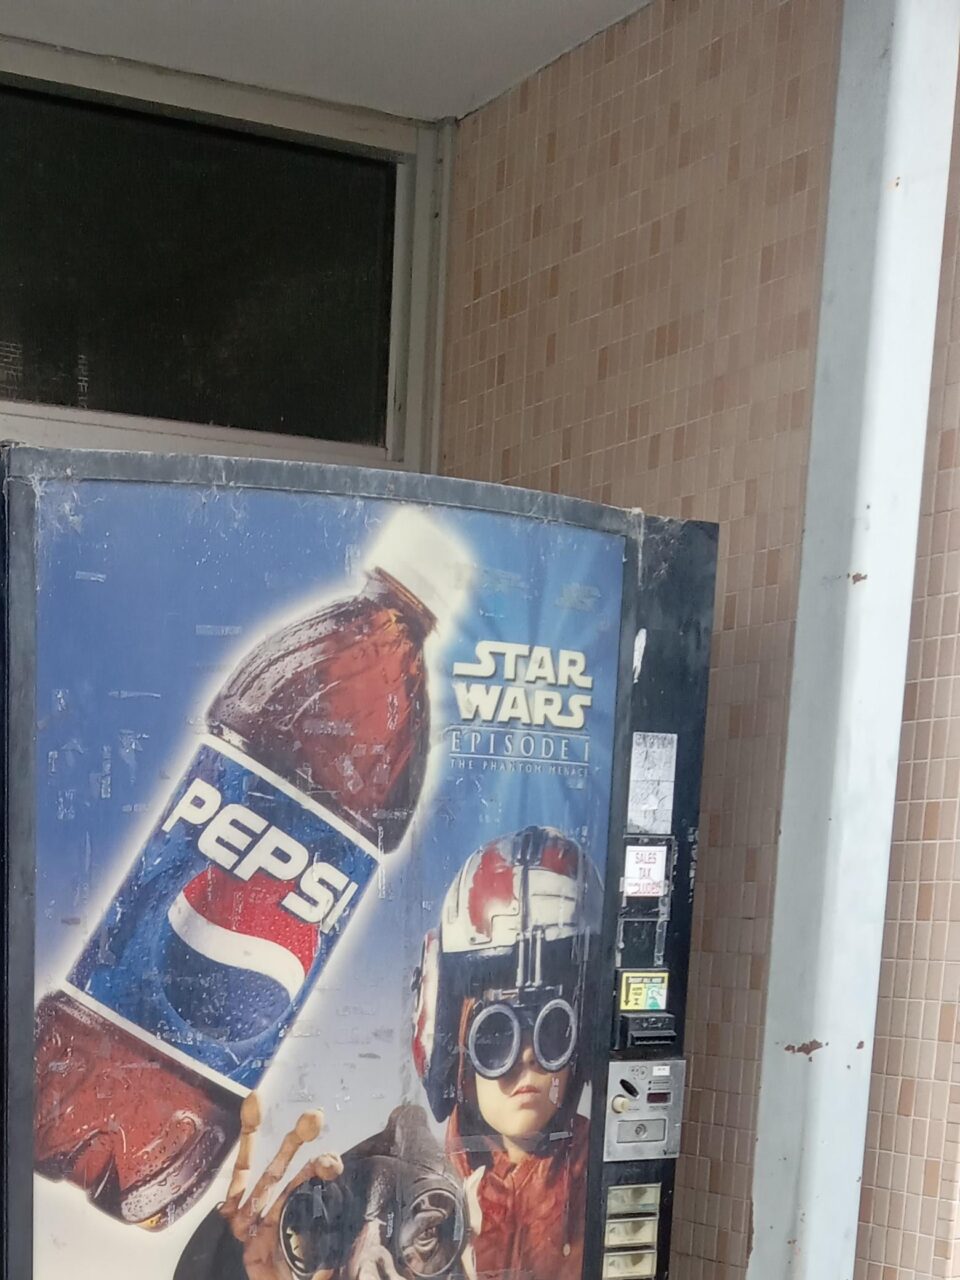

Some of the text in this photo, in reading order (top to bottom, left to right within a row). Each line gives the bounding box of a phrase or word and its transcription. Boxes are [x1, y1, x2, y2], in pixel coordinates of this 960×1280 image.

[452, 640, 593, 689] STAR
[452, 682, 592, 729] WARS
[451, 731, 569, 760] EPISODE
[451, 760, 473, 770] THE
[483, 761, 541, 773] PHANTOM
[161, 778, 358, 934] PEPSI
[635, 852, 657, 864] SALES
[640, 867, 651, 877] TAX
